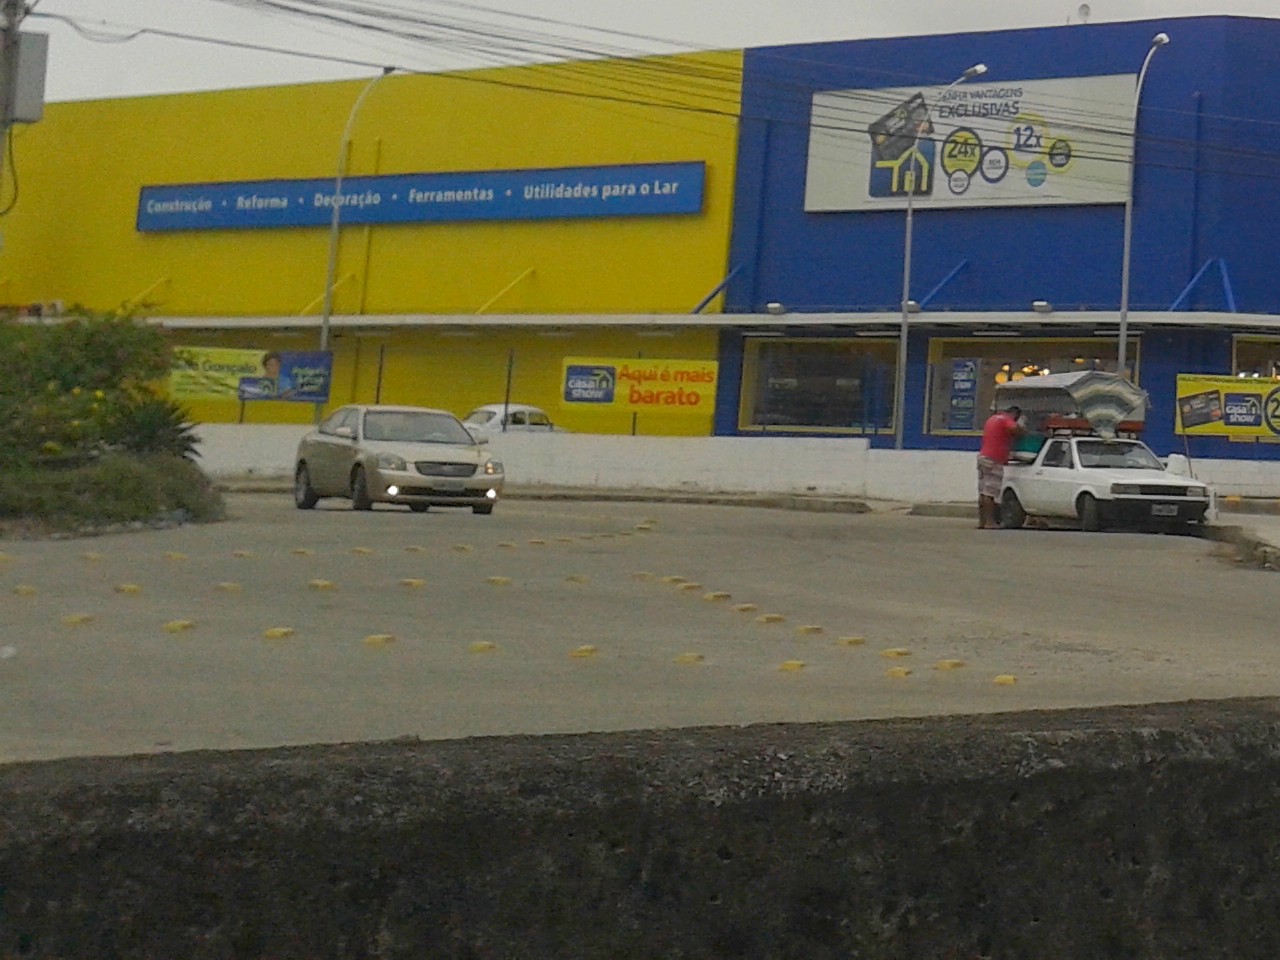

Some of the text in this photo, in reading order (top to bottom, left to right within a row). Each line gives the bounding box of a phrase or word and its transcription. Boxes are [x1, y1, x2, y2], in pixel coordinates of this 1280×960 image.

[938, 101, 1020, 118] EXCLUSIVAS
[947, 139, 976, 159] 24x
[146, 180, 679, 215] Construção Reforma Decoração Ferramentas Utilidades para o Lar
[568, 379, 596, 389] casa
[618, 365, 715, 385] Aqui é mais
[628, 384, 701, 406] barato
[1225, 405, 1248, 414] casa
[1229, 413, 1255, 424] show
